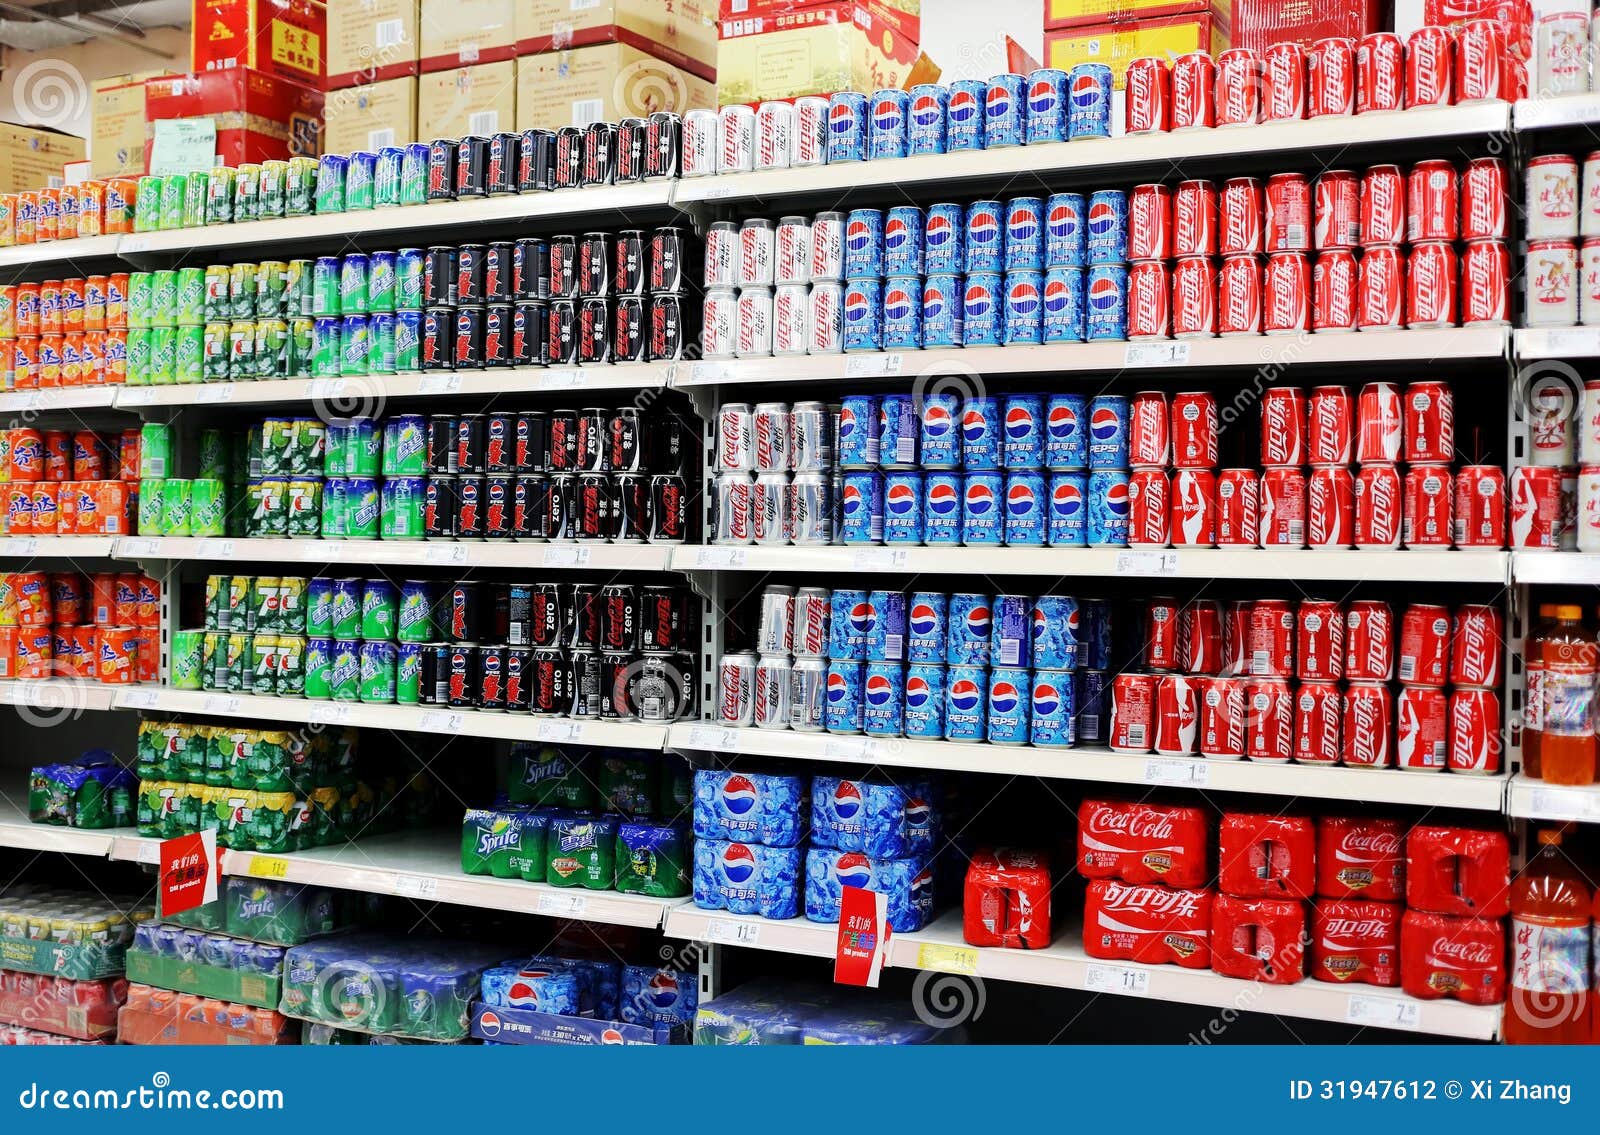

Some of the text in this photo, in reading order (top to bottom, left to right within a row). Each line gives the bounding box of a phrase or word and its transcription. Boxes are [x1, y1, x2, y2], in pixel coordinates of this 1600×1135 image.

[586, 426, 596, 454] zero
[1089, 444, 1119, 454] PEPSI
[552, 494, 560, 522] zero
[547, 602, 555, 631] zero
[624, 605, 633, 634] zero
[805, 594, 824, 654] 可口可乐
[554, 670, 562, 698] zero
[683, 672, 691, 701] zero
[950, 714, 979, 724] PEPSI
[989, 716, 1018, 727] PEPSI
[527, 757, 567, 783] Sprite
[719, 817, 758, 831] 百事可乐
[831, 821, 861, 835] 百事可乐
[478, 829, 519, 853] Sprite
[171, 854, 199, 871] 我们的
[179, 879, 202, 892] product
[719, 886, 758, 900] 百事可乐
[240, 899, 275, 918] Sprite
[1104, 882, 1206, 919] 可口可乐
[847, 915, 872, 932] 我们的
[1325, 918, 1392, 939] 可口可乐
[840, 930, 876, 951] 广告商品
[852, 950, 869, 959] product
